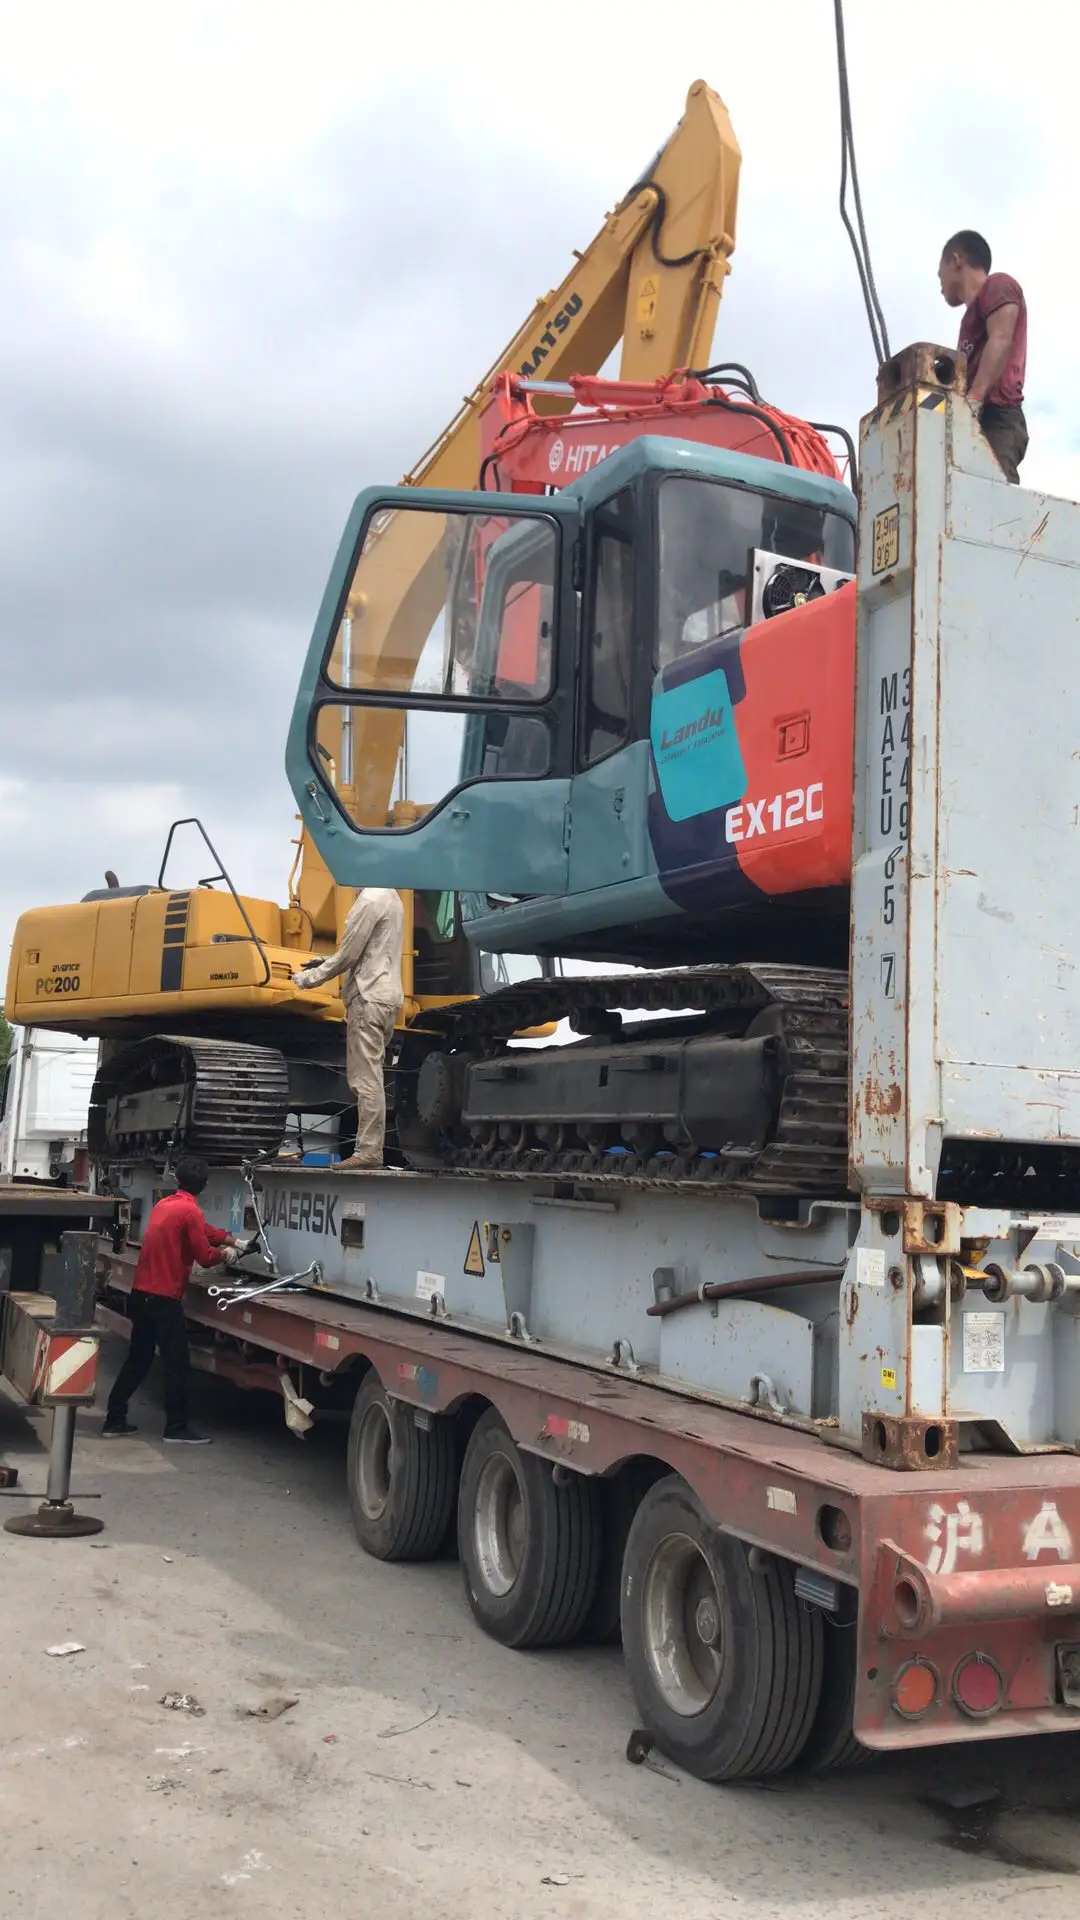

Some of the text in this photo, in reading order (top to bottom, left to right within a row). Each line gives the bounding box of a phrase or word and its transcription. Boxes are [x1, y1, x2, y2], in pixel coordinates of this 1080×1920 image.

[36, 976, 80, 995] PC200
[209, 971, 239, 981] KOMATSU
[263, 1189, 339, 1237] MAERSK
[925, 1500, 1073, 1575] 沪 A
